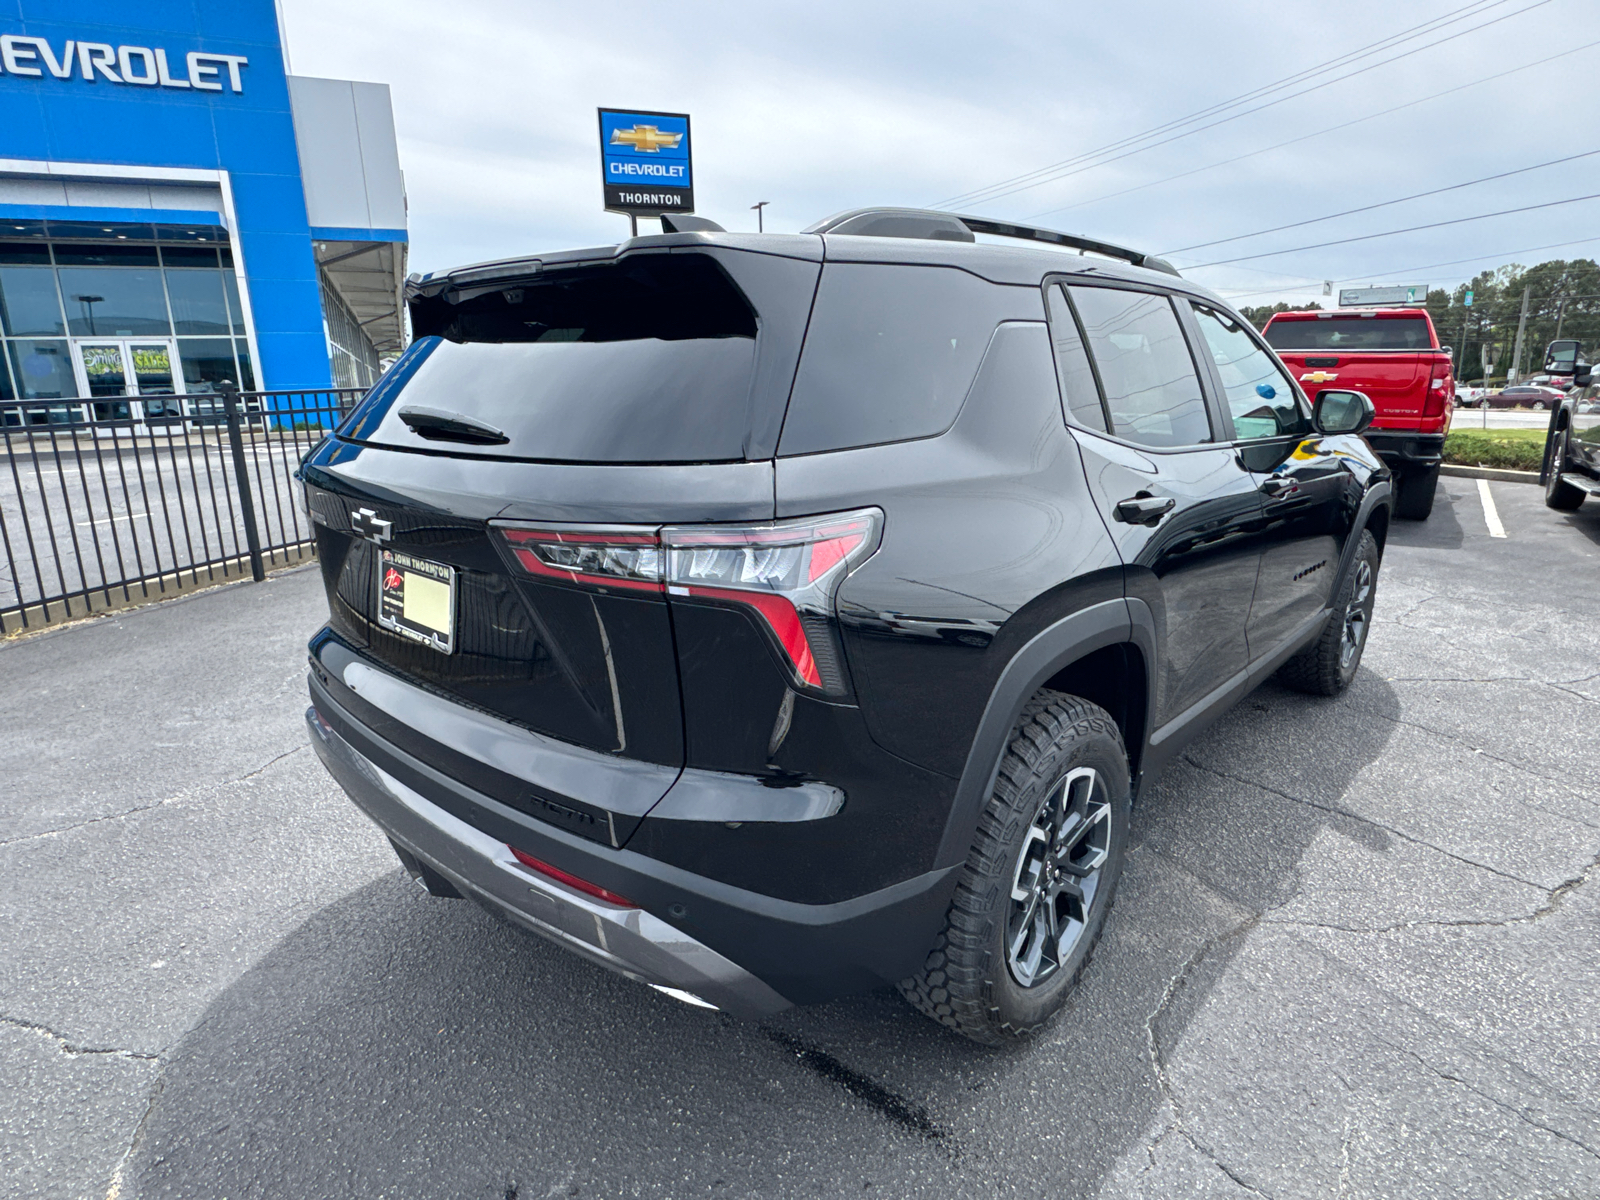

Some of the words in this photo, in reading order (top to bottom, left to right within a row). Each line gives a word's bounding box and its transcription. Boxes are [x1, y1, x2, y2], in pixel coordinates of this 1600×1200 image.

[0, 34, 249, 92] EVROLET
[610, 162, 685, 177] CHEVROLET
[618, 192, 681, 205] THORNTON
[394, 553, 411, 567] JOHN
[411, 558, 449, 579] THORNTON
